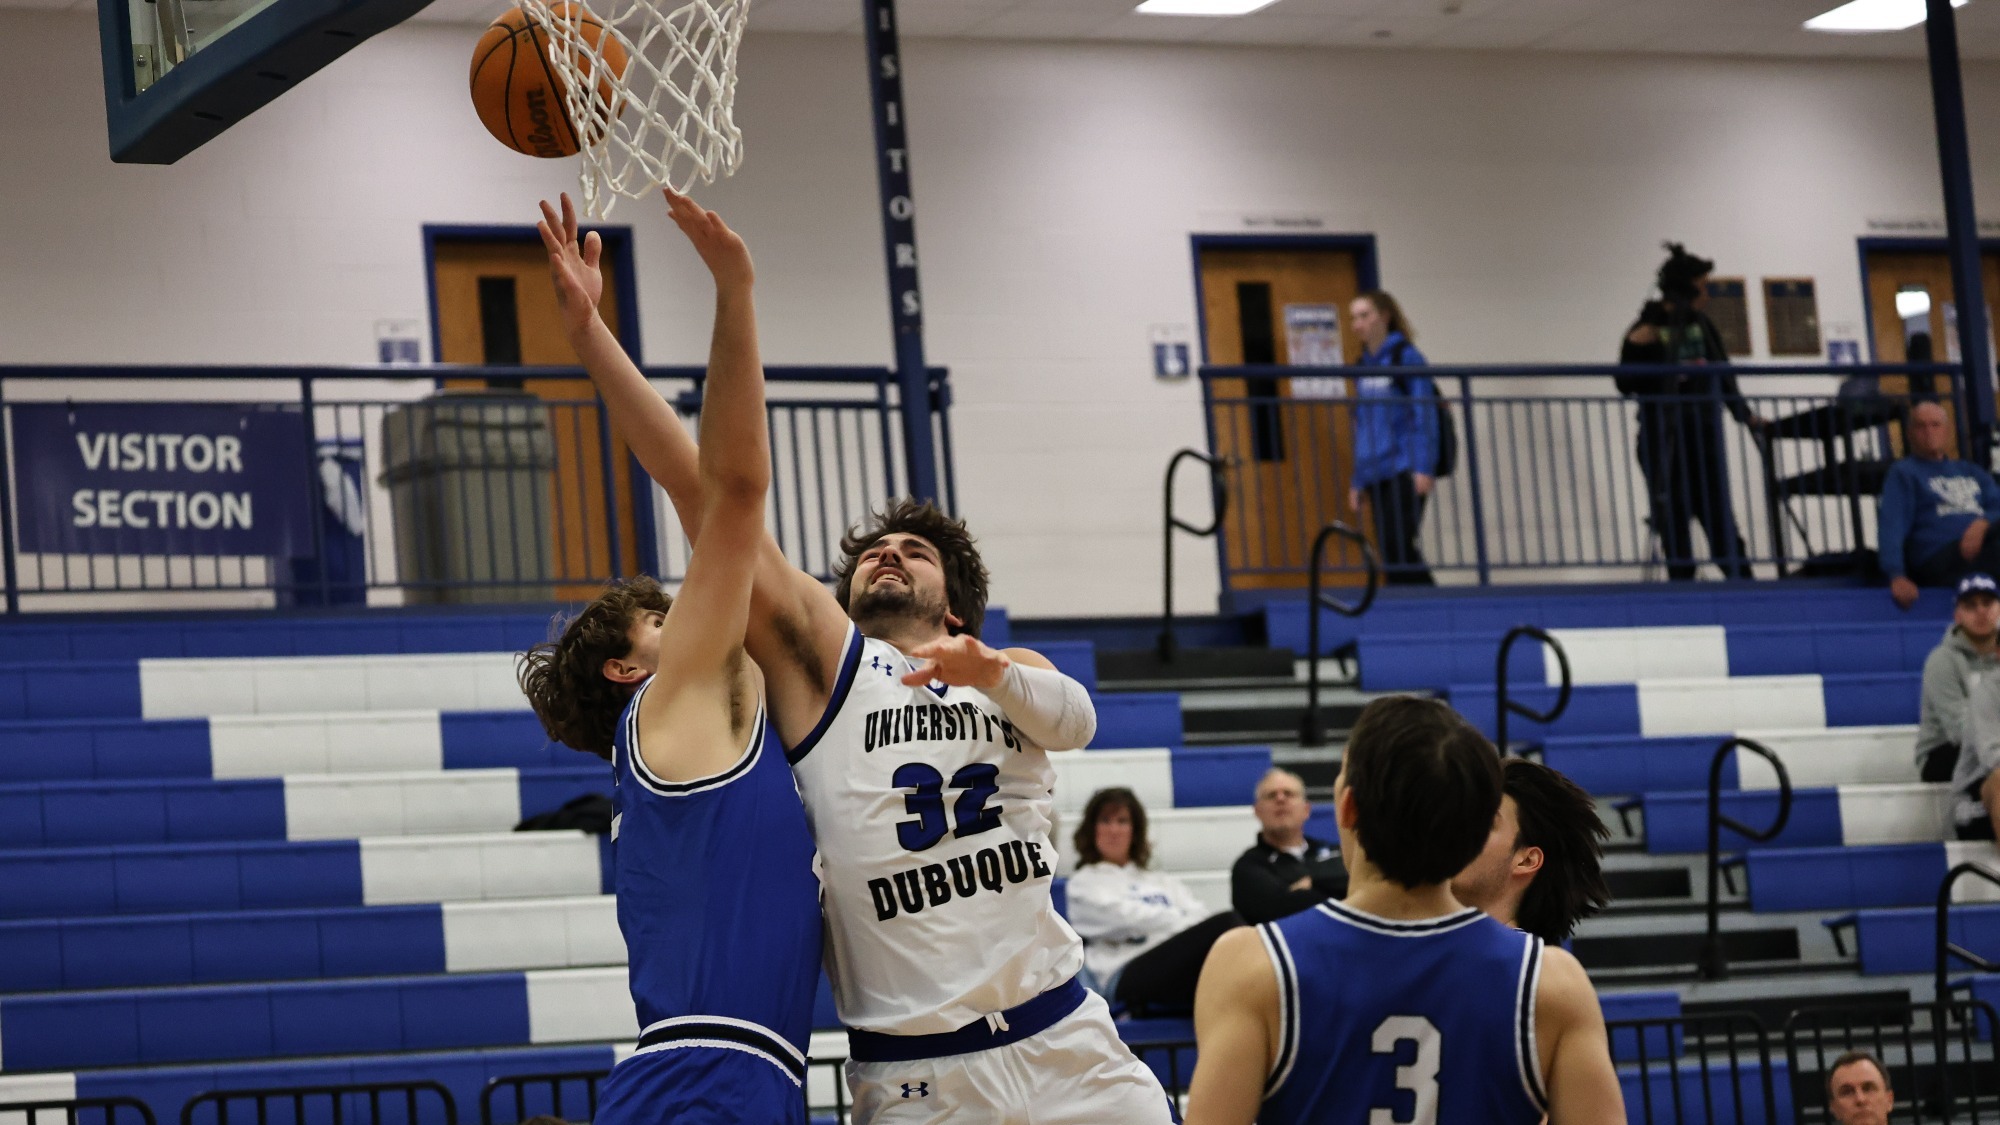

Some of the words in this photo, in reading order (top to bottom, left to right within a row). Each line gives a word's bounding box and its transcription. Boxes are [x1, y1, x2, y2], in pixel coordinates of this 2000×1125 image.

[75, 431, 244, 473] VISITOR
[72, 489, 253, 530] SECTION
[892, 762, 1004, 852] 32
[867, 839, 1052, 922] DUBUQUE
[1369, 1015, 1442, 1125] 3
